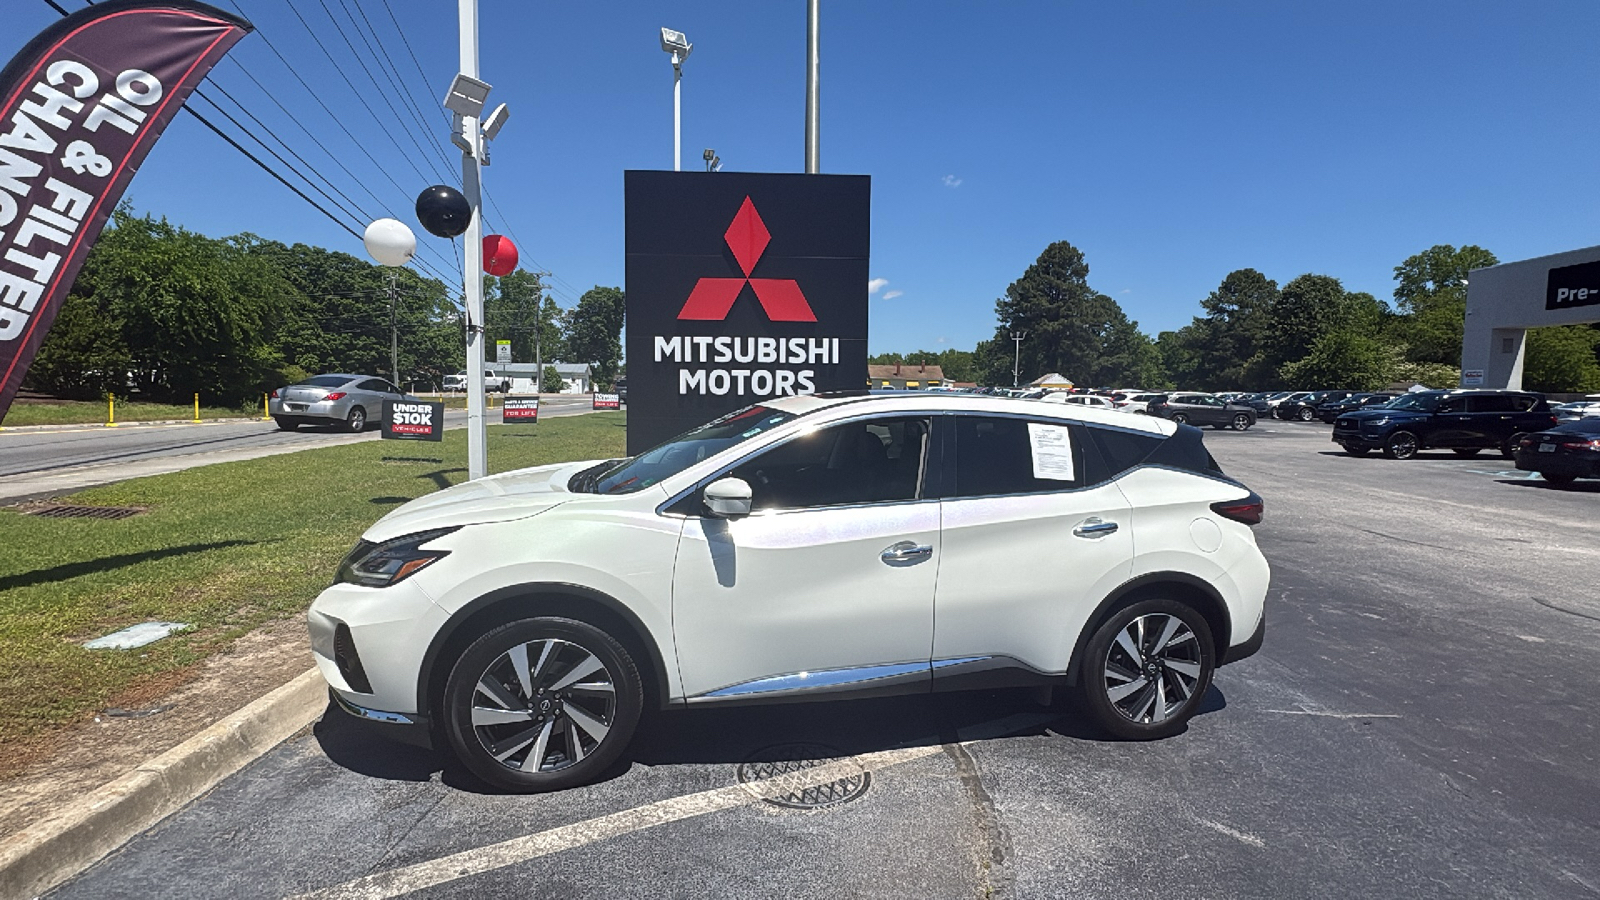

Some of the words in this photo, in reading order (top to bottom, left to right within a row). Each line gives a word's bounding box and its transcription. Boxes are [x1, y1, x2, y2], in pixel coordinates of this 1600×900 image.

[83, 69, 163, 136] OIL
[60, 140, 113, 178] &
[1557, 287, 1599, 302] Pre-
[654, 336, 840, 364] MITSUBISHI
[679, 369, 815, 396] MOTORS
[393, 403, 432, 413] UNDER
[393, 412, 432, 425] $10K
